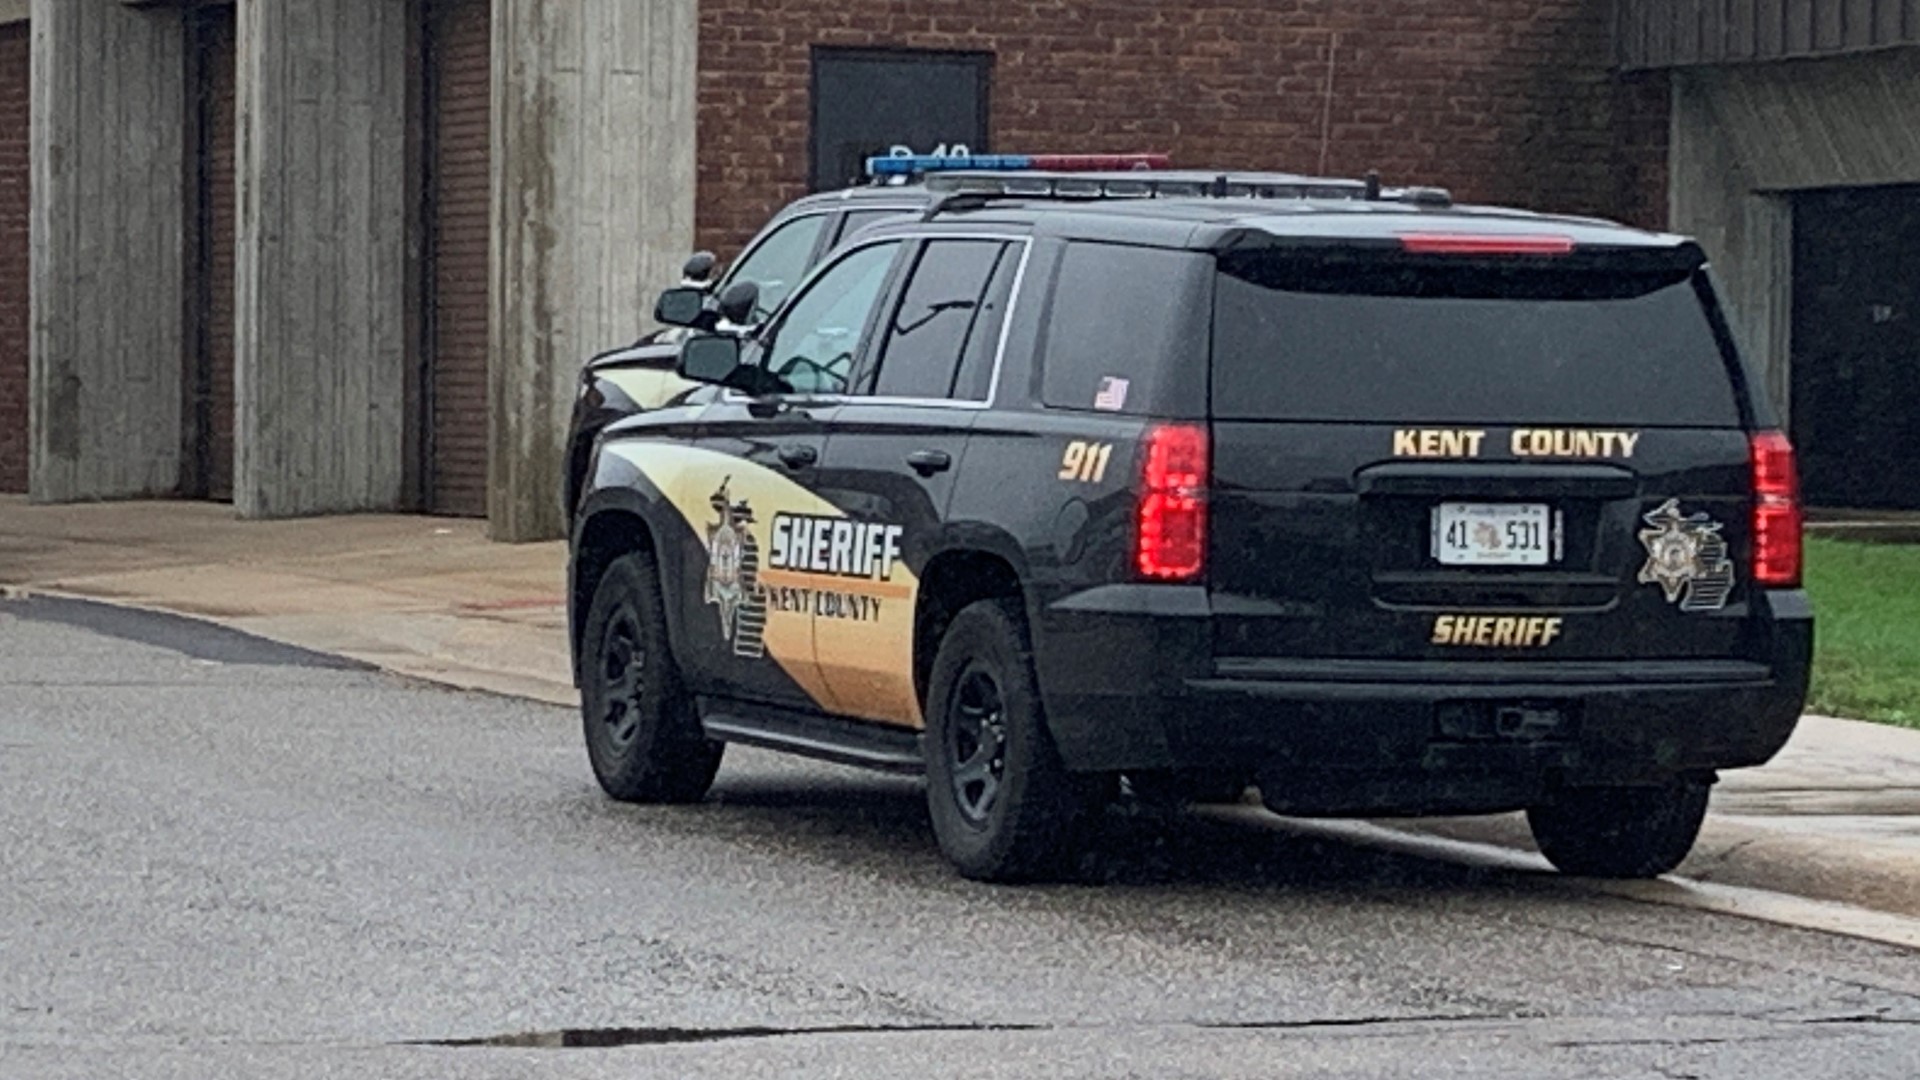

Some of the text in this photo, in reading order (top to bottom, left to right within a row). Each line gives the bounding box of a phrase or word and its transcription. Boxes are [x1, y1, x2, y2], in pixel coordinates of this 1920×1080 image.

[1392, 429, 1640, 458] KENT COUNTY
[1057, 440, 1113, 483] 911
[769, 512, 904, 581] SHERIFF
[1446, 520, 1541, 550] 41 531
[814, 589, 882, 622] COUNTY
[1431, 613, 1563, 647] SHERIFF
